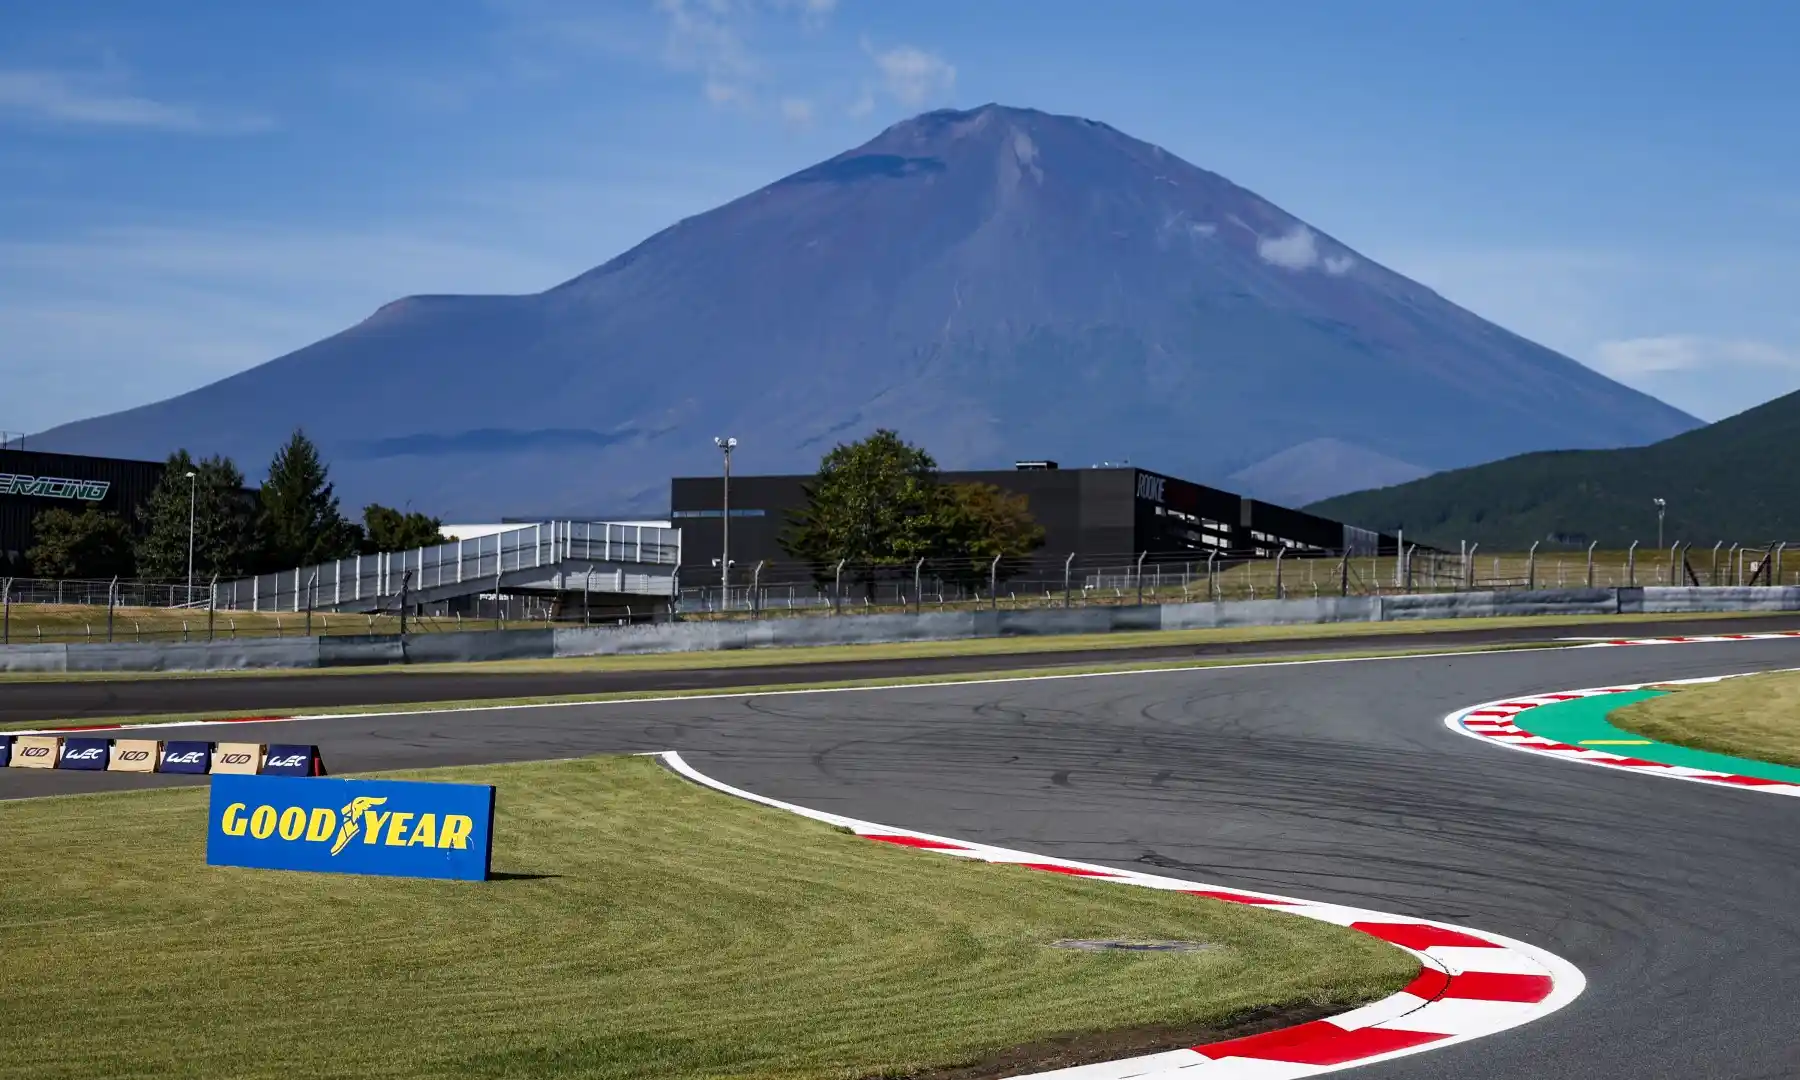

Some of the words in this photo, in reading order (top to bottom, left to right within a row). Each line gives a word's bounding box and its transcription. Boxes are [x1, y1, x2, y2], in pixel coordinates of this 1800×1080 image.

[65, 748, 104, 760] WEC
[166, 752, 205, 764] WEC
[268, 755, 306, 767] WEC
